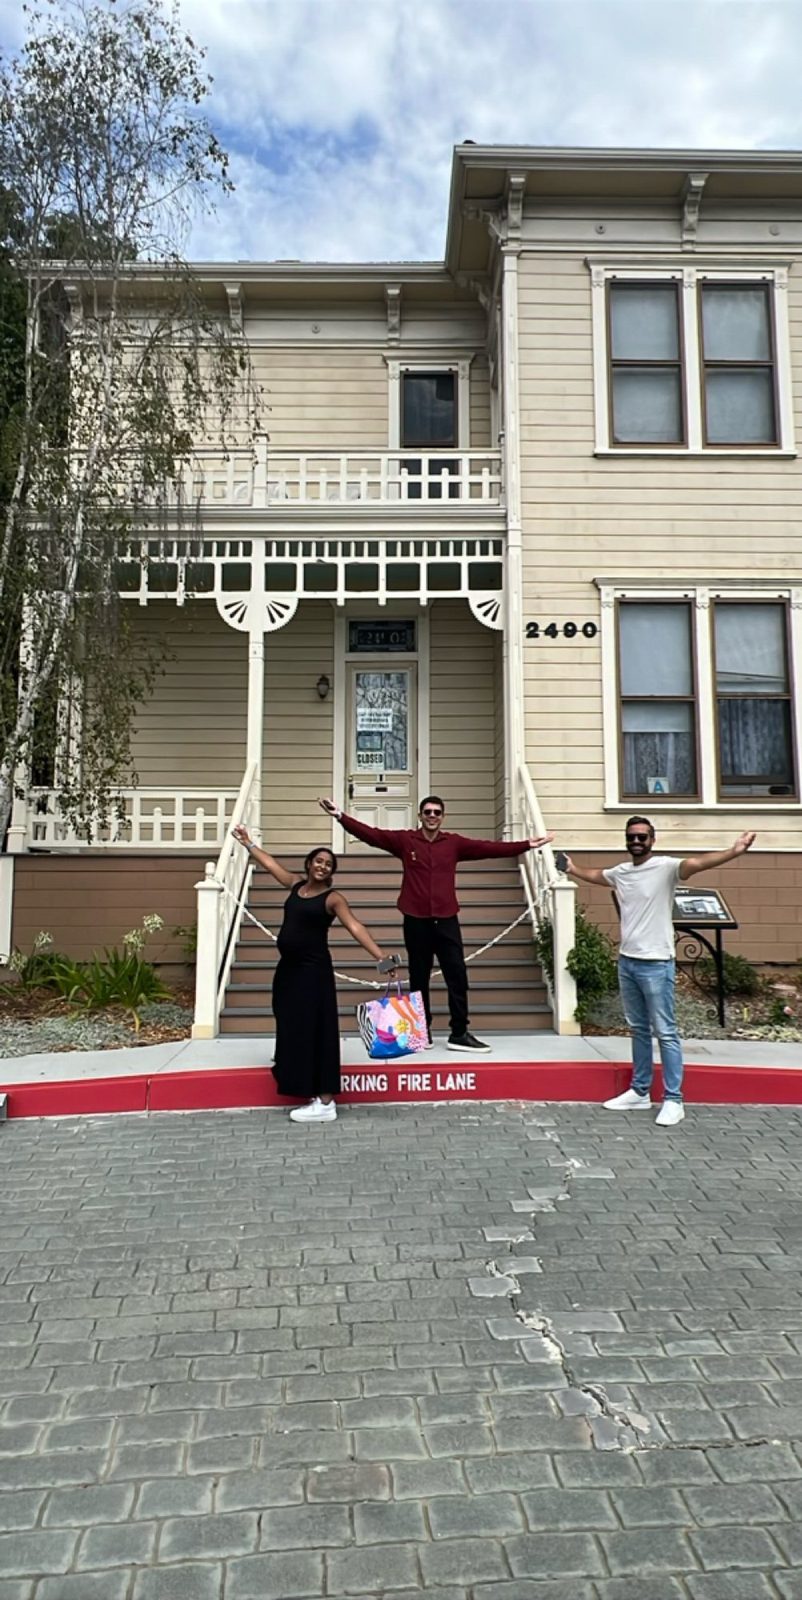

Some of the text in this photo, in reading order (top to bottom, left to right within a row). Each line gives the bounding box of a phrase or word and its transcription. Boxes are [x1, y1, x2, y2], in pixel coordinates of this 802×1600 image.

[525, 621, 597, 639] 2490
[357, 753, 383, 764] CLOSED
[340, 1072, 476, 1092] RKING FIRE LANE
